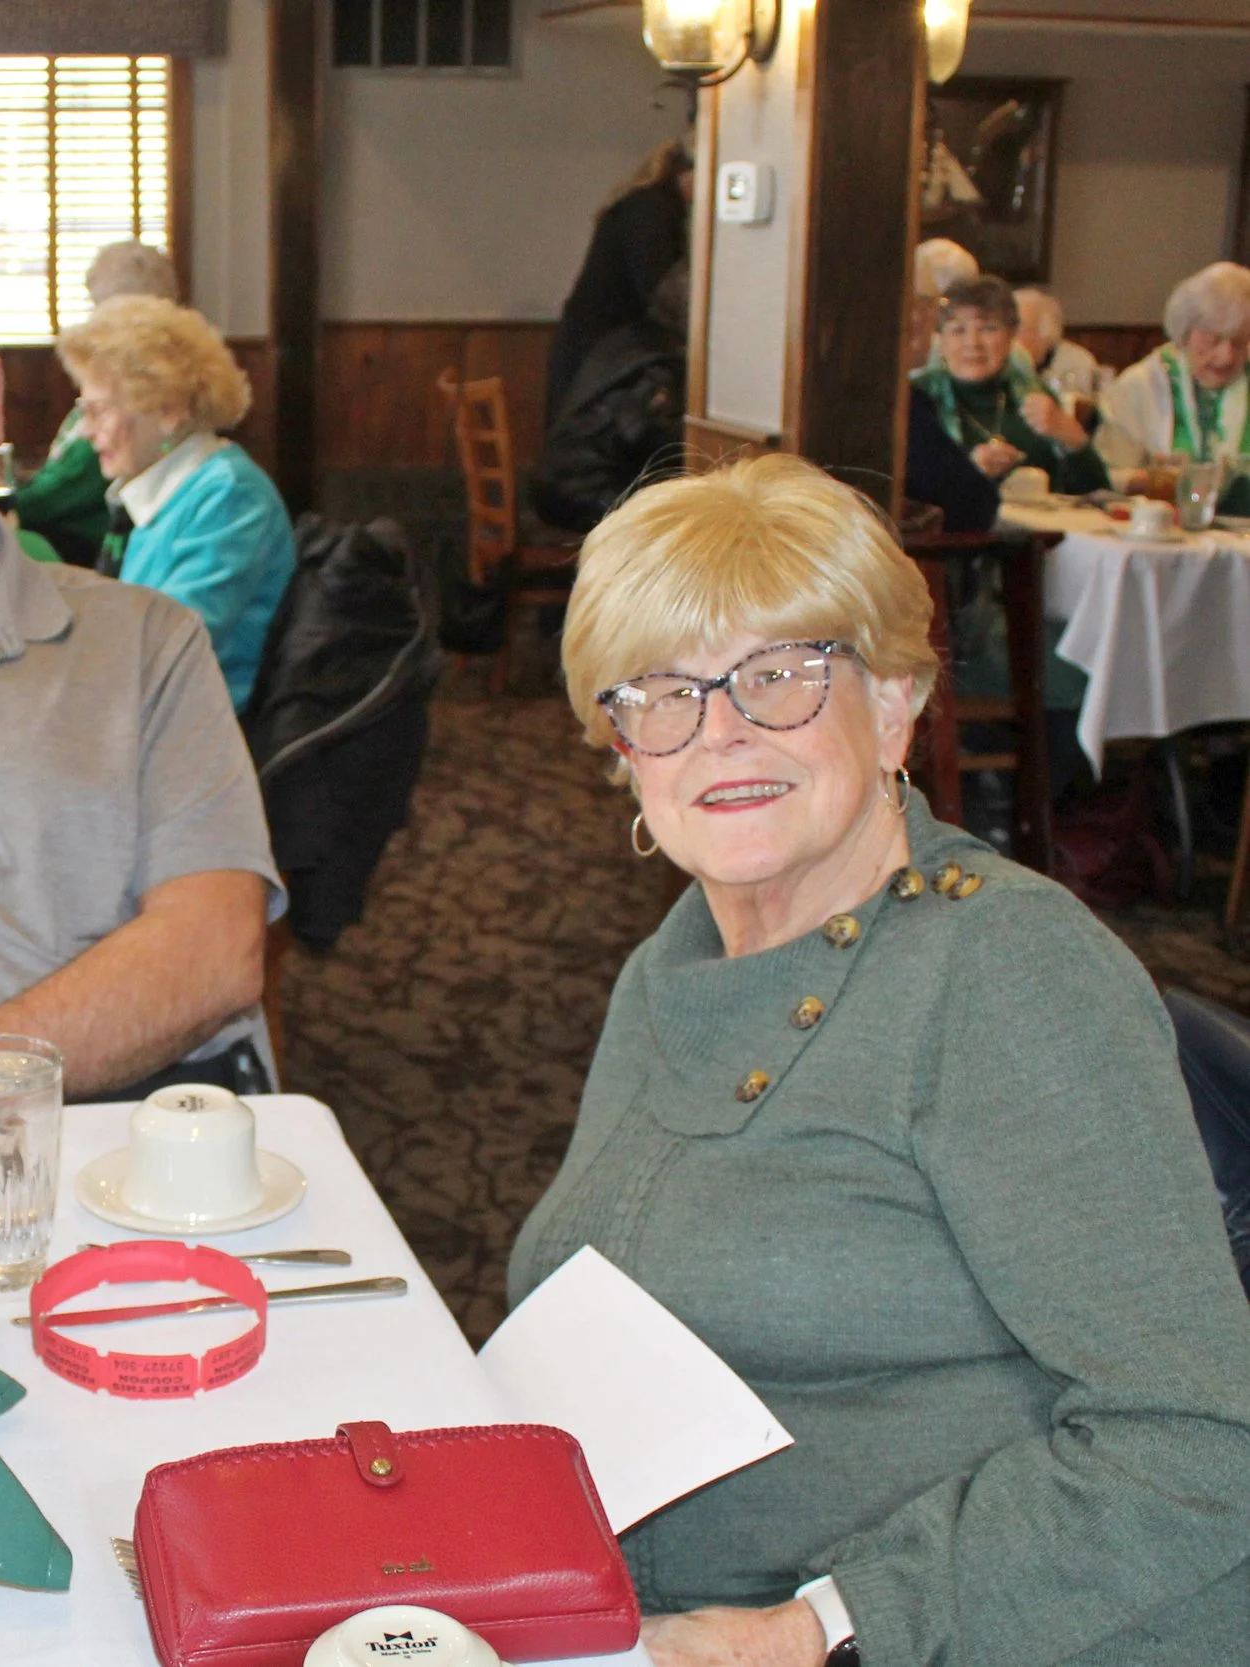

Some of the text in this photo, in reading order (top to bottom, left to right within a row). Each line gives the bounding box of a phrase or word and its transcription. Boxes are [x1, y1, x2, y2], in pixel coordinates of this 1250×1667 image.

[118, 1375, 183, 1385] COUPON
[112, 1382, 191, 1394] KEEP THIS
